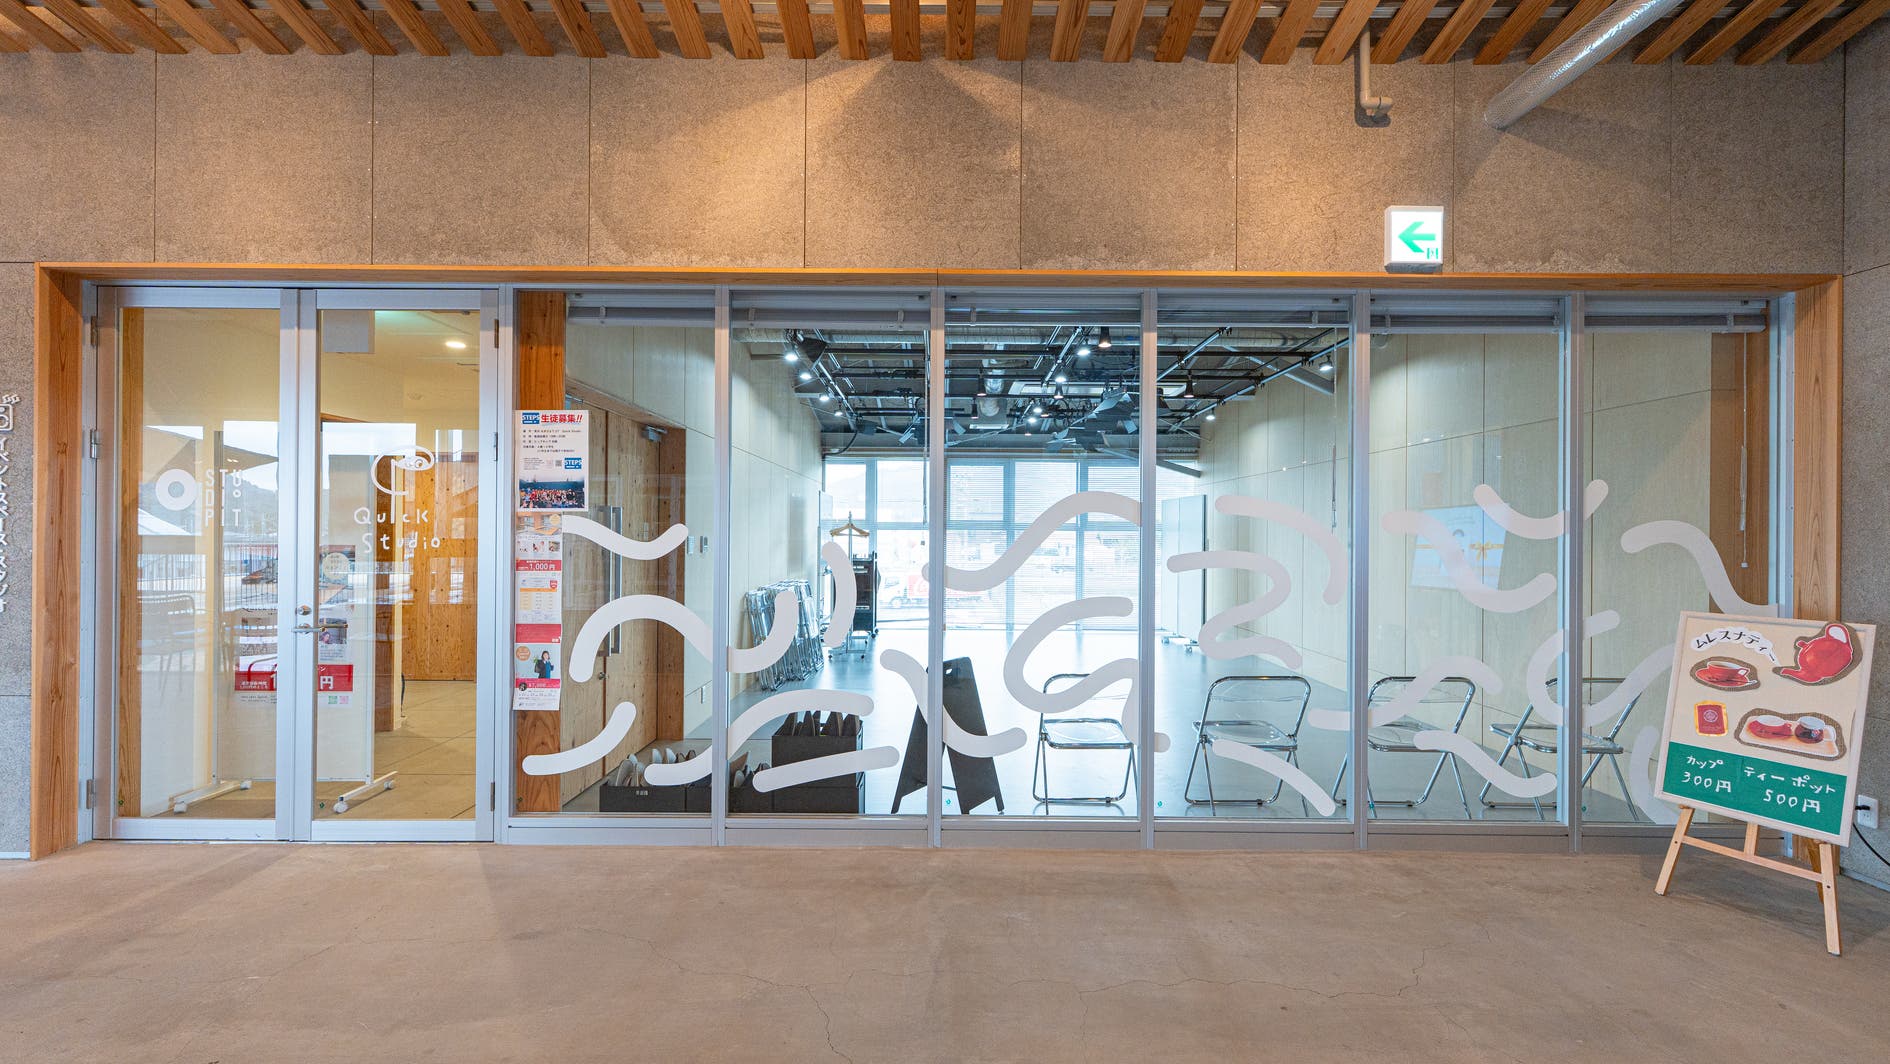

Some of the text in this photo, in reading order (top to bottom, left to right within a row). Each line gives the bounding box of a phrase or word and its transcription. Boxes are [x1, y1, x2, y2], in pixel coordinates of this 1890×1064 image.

[362, 531, 440, 553] Studio
[1696, 630, 1775, 662] ムレスナティー
[1686, 755, 1724, 769] カップ
[1681, 771, 1821, 813] 300円 500円
